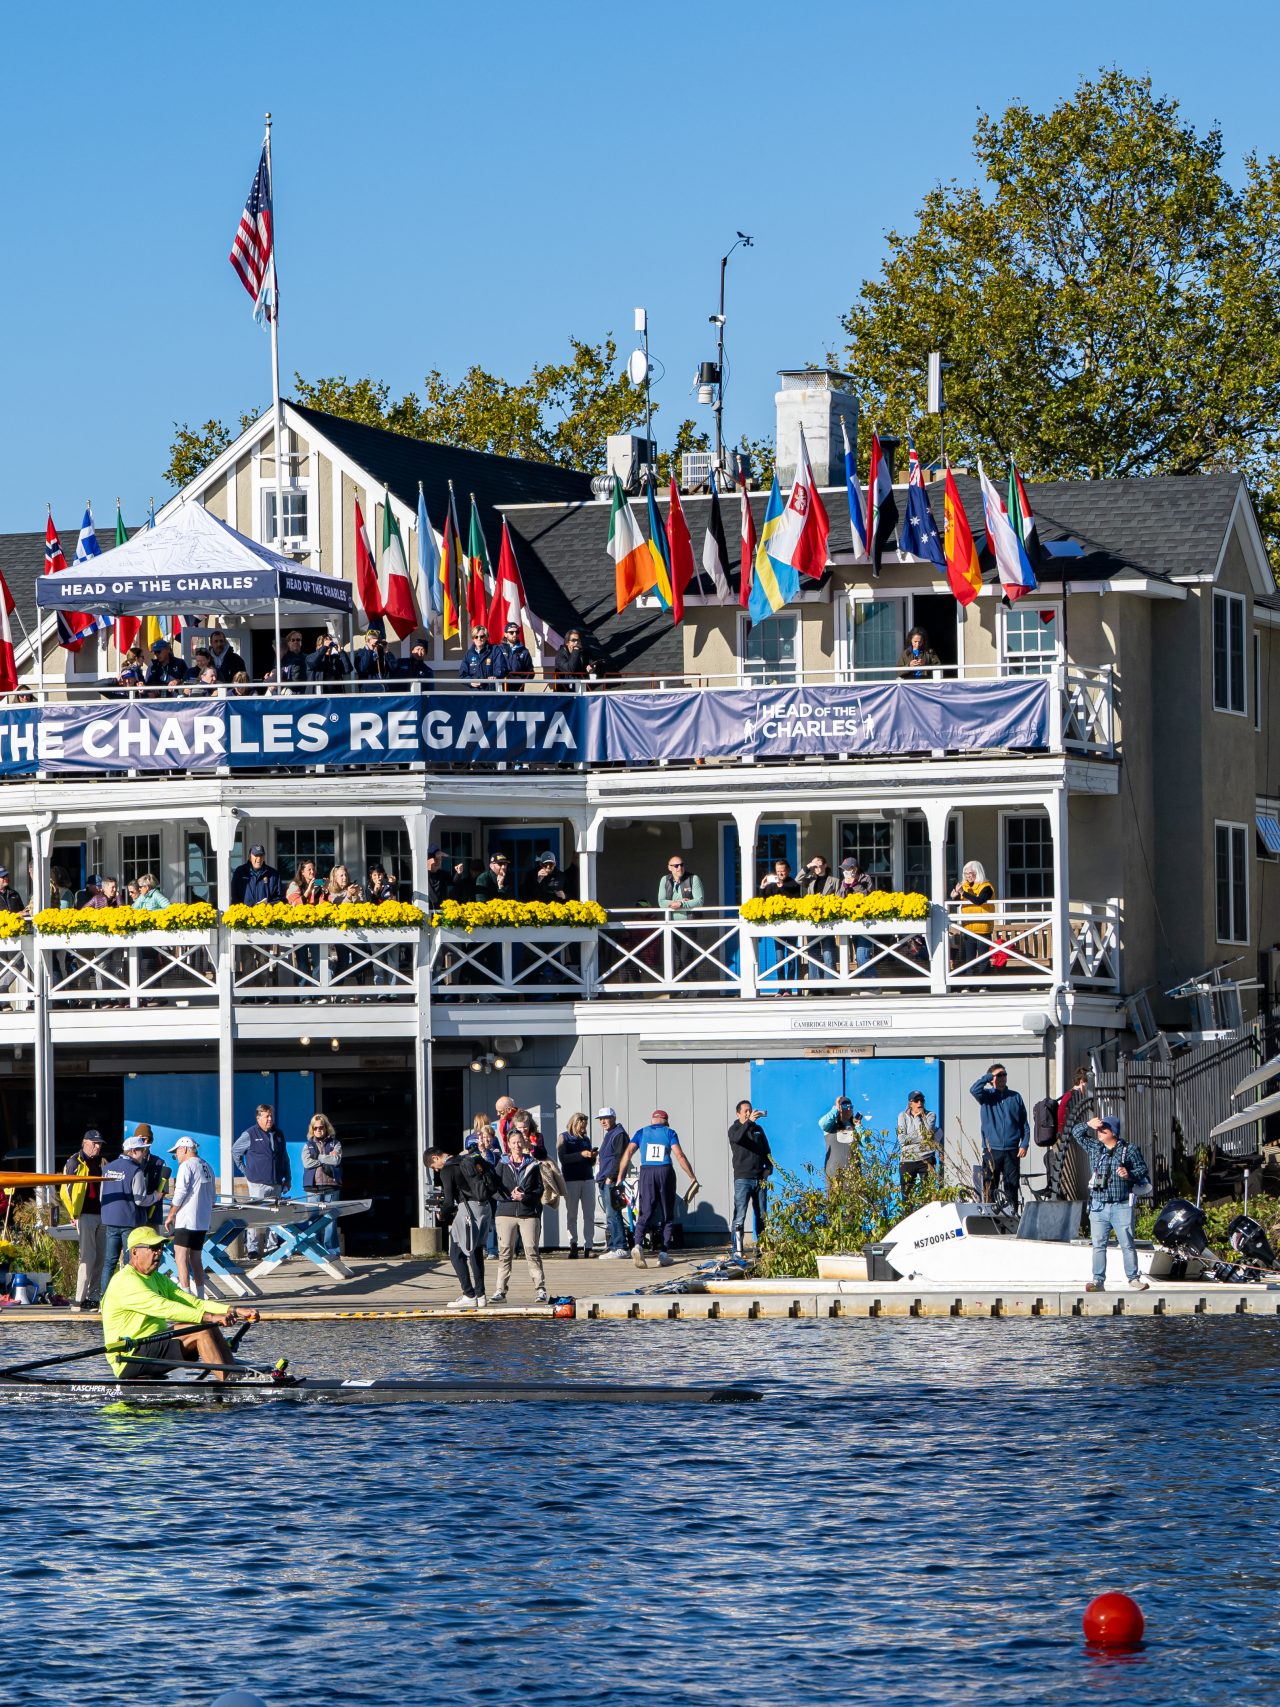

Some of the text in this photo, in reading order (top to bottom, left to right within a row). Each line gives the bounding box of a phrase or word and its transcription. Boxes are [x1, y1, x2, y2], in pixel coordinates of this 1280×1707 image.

[61, 577, 254, 596] HEAD OF THE CHARLES
[285, 578, 302, 591] HEAD
[302, 581, 311, 592] OF
[311, 583, 323, 596] THE
[323, 586, 347, 602] CHARLES
[762, 704, 856, 718] HEAD OF THE
[349, 709, 577, 752] REGATTA
[762, 719, 858, 739] CHARLES
[651, 1146, 661, 1158] 11
